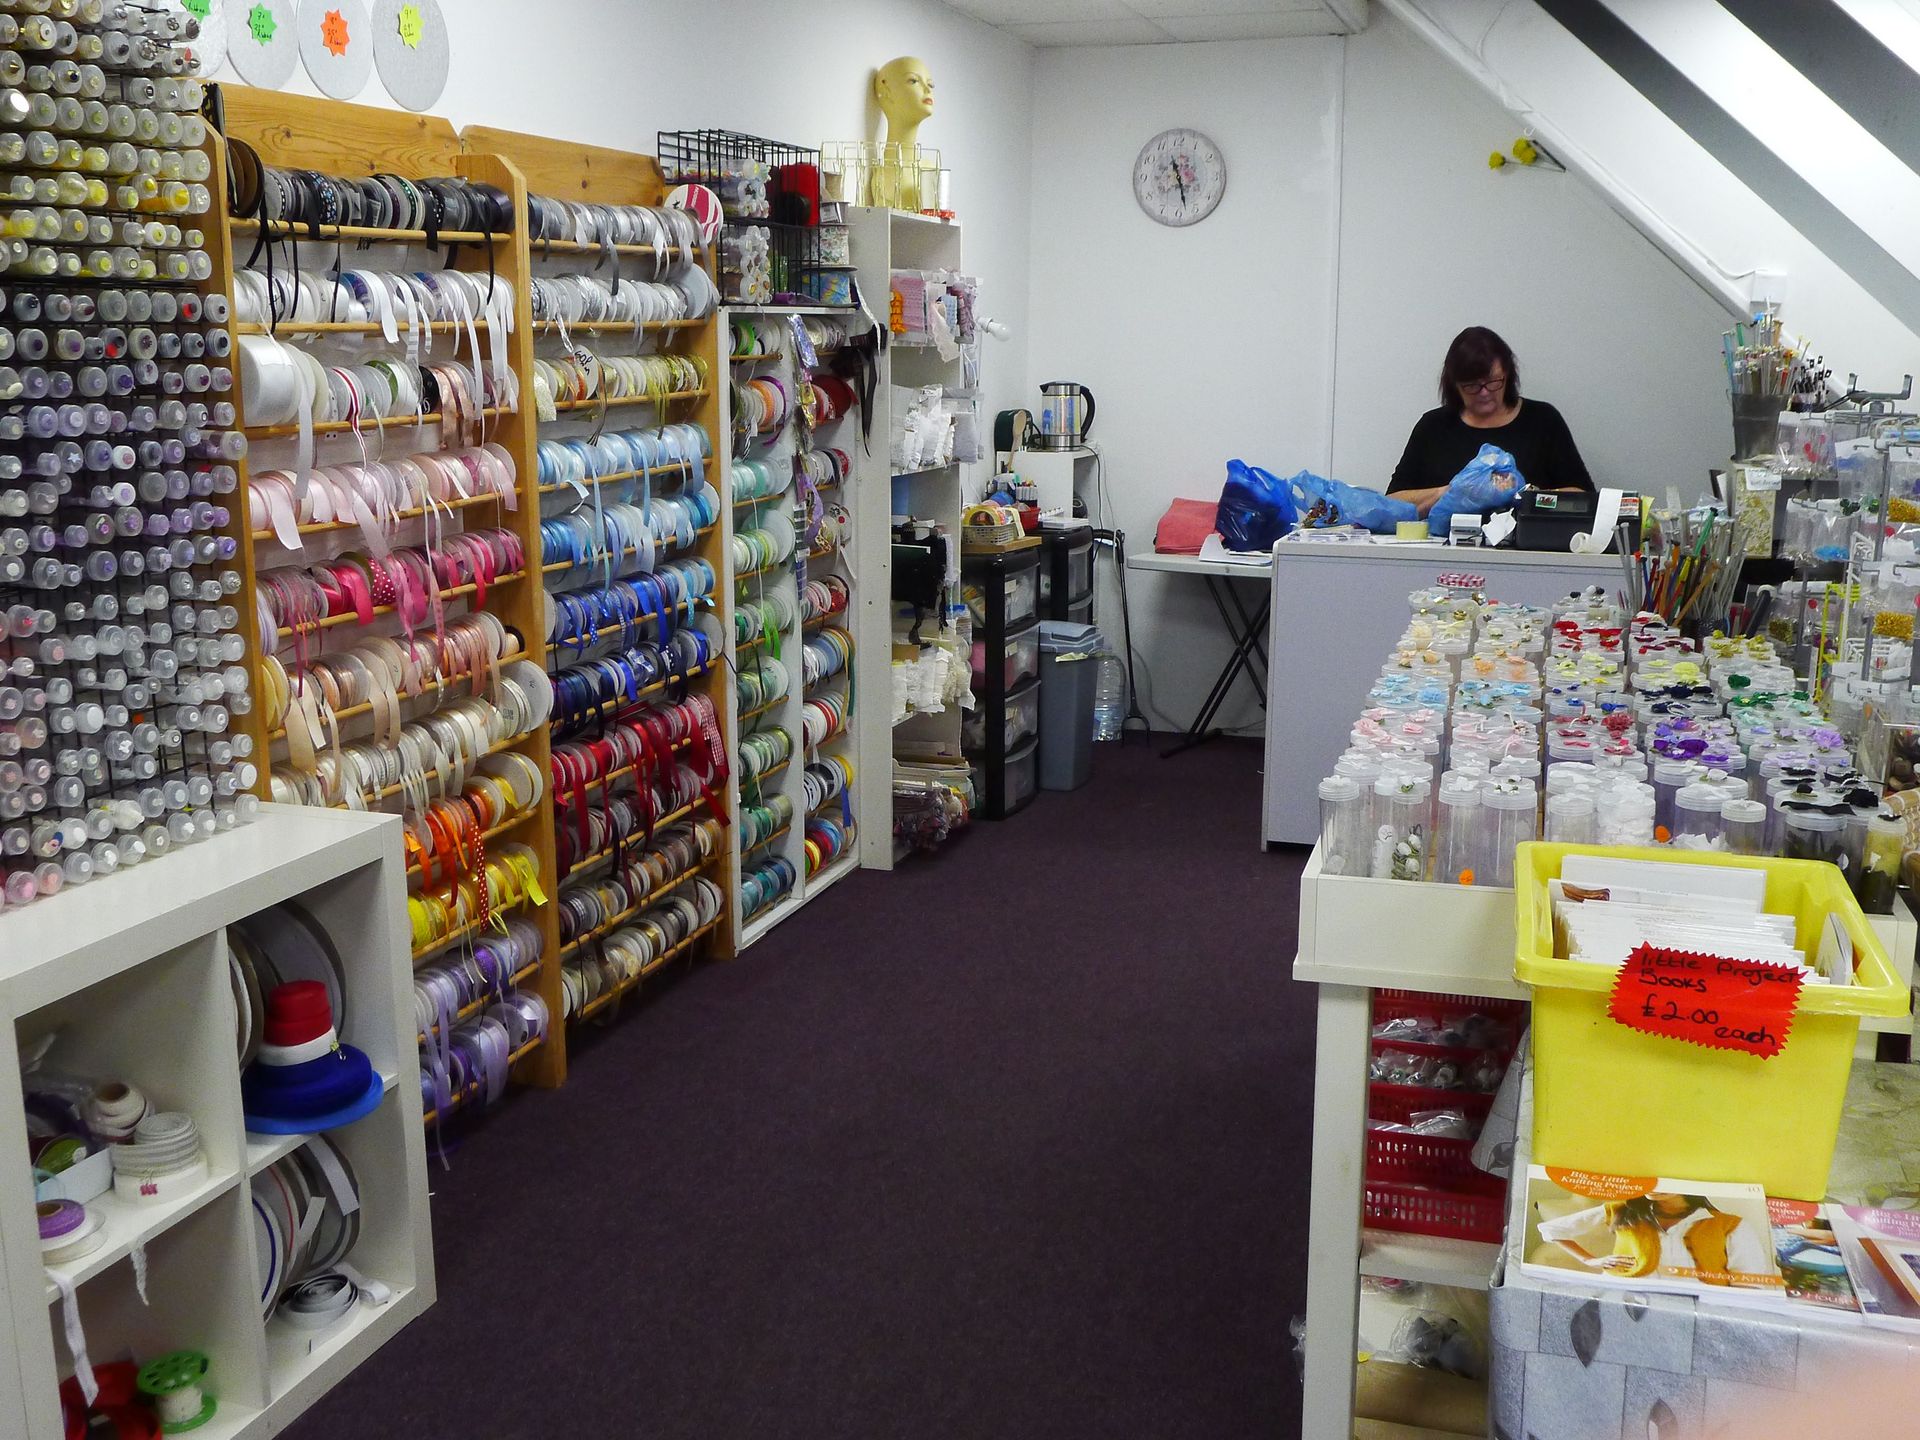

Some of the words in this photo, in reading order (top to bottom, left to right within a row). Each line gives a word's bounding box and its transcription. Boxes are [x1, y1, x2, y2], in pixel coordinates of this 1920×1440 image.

[1157, 140, 1167, 151] 11
[1173, 137, 1185, 147] 12
[1144, 154, 1156, 165] 10
[1205, 153, 1214, 163] 2
[1140, 172, 1148, 183] 9
[1145, 191, 1153, 201] 8
[1160, 204, 1166, 215] 7
[1174, 208, 1183, 218] 6
[1191, 204, 1199, 214] 5
[1638, 968, 1707, 993] Books
[1641, 993, 1720, 1025] £2.00
[1714, 1026, 1776, 1047] each
[1570, 1170, 1589, 1180] Big
[1601, 1175, 1630, 1183] Little
[1560, 1175, 1602, 1188] Knitting
[1604, 1182, 1643, 1191] Projects
[1871, 1209, 1890, 1218] Big
[1683, 1269, 1736, 1281] Holiday
[1741, 1274, 1777, 1284] Knits
